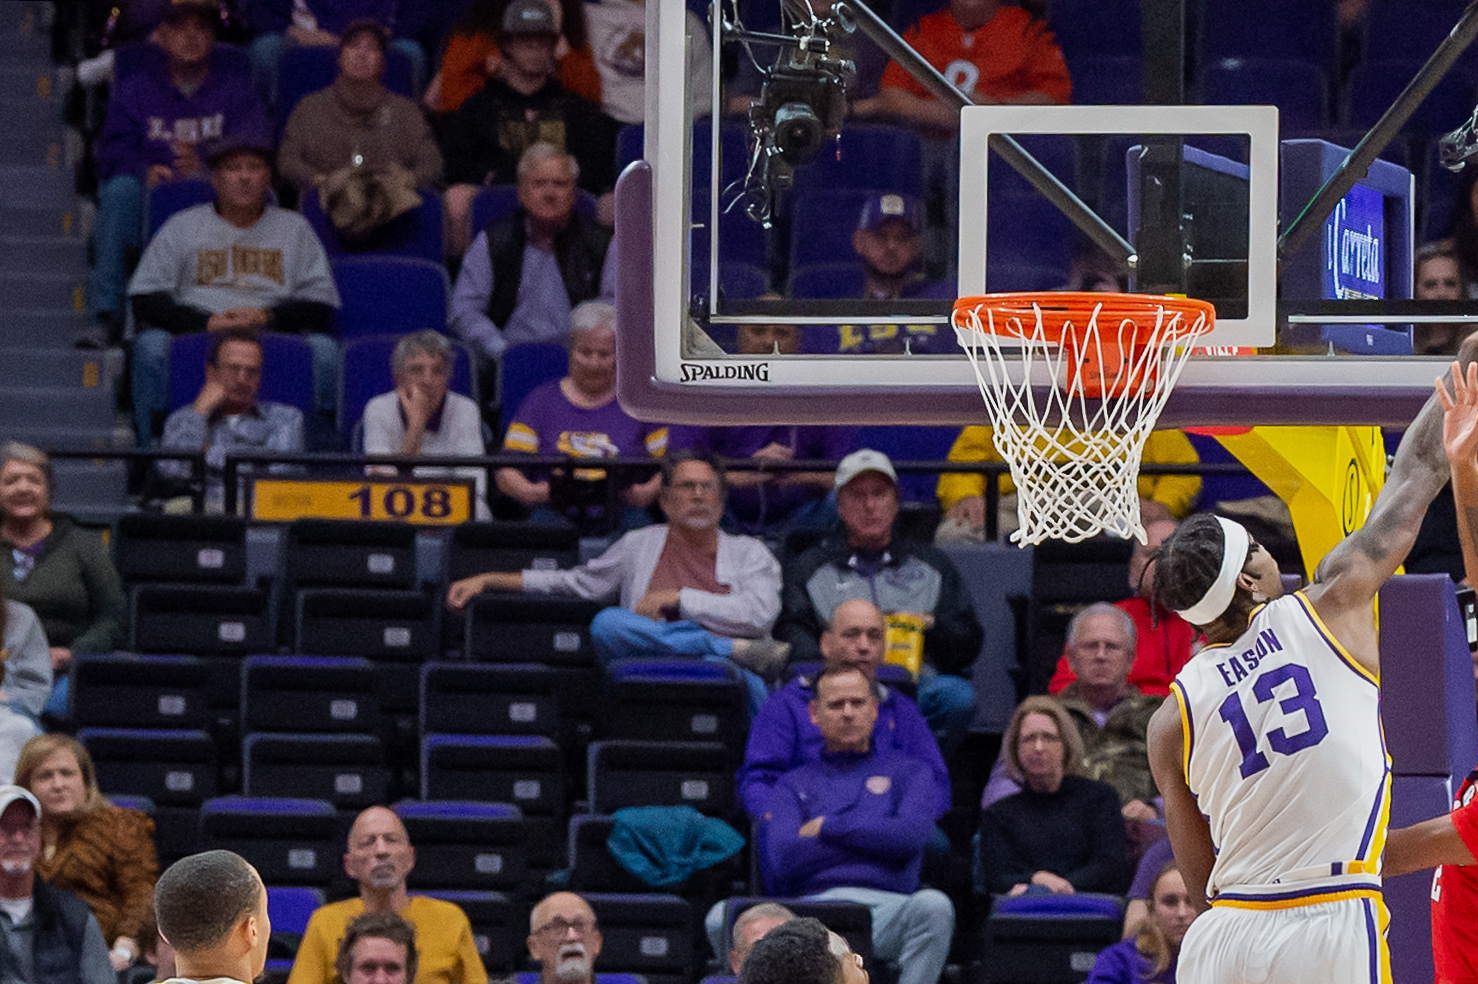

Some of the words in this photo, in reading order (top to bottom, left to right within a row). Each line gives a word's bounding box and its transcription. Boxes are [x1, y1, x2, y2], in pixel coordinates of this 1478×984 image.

[680, 362, 769, 382] SPALDING
[348, 488, 453, 519] 108
[1216, 628, 1283, 687] EASON
[1219, 663, 1329, 779] 13
